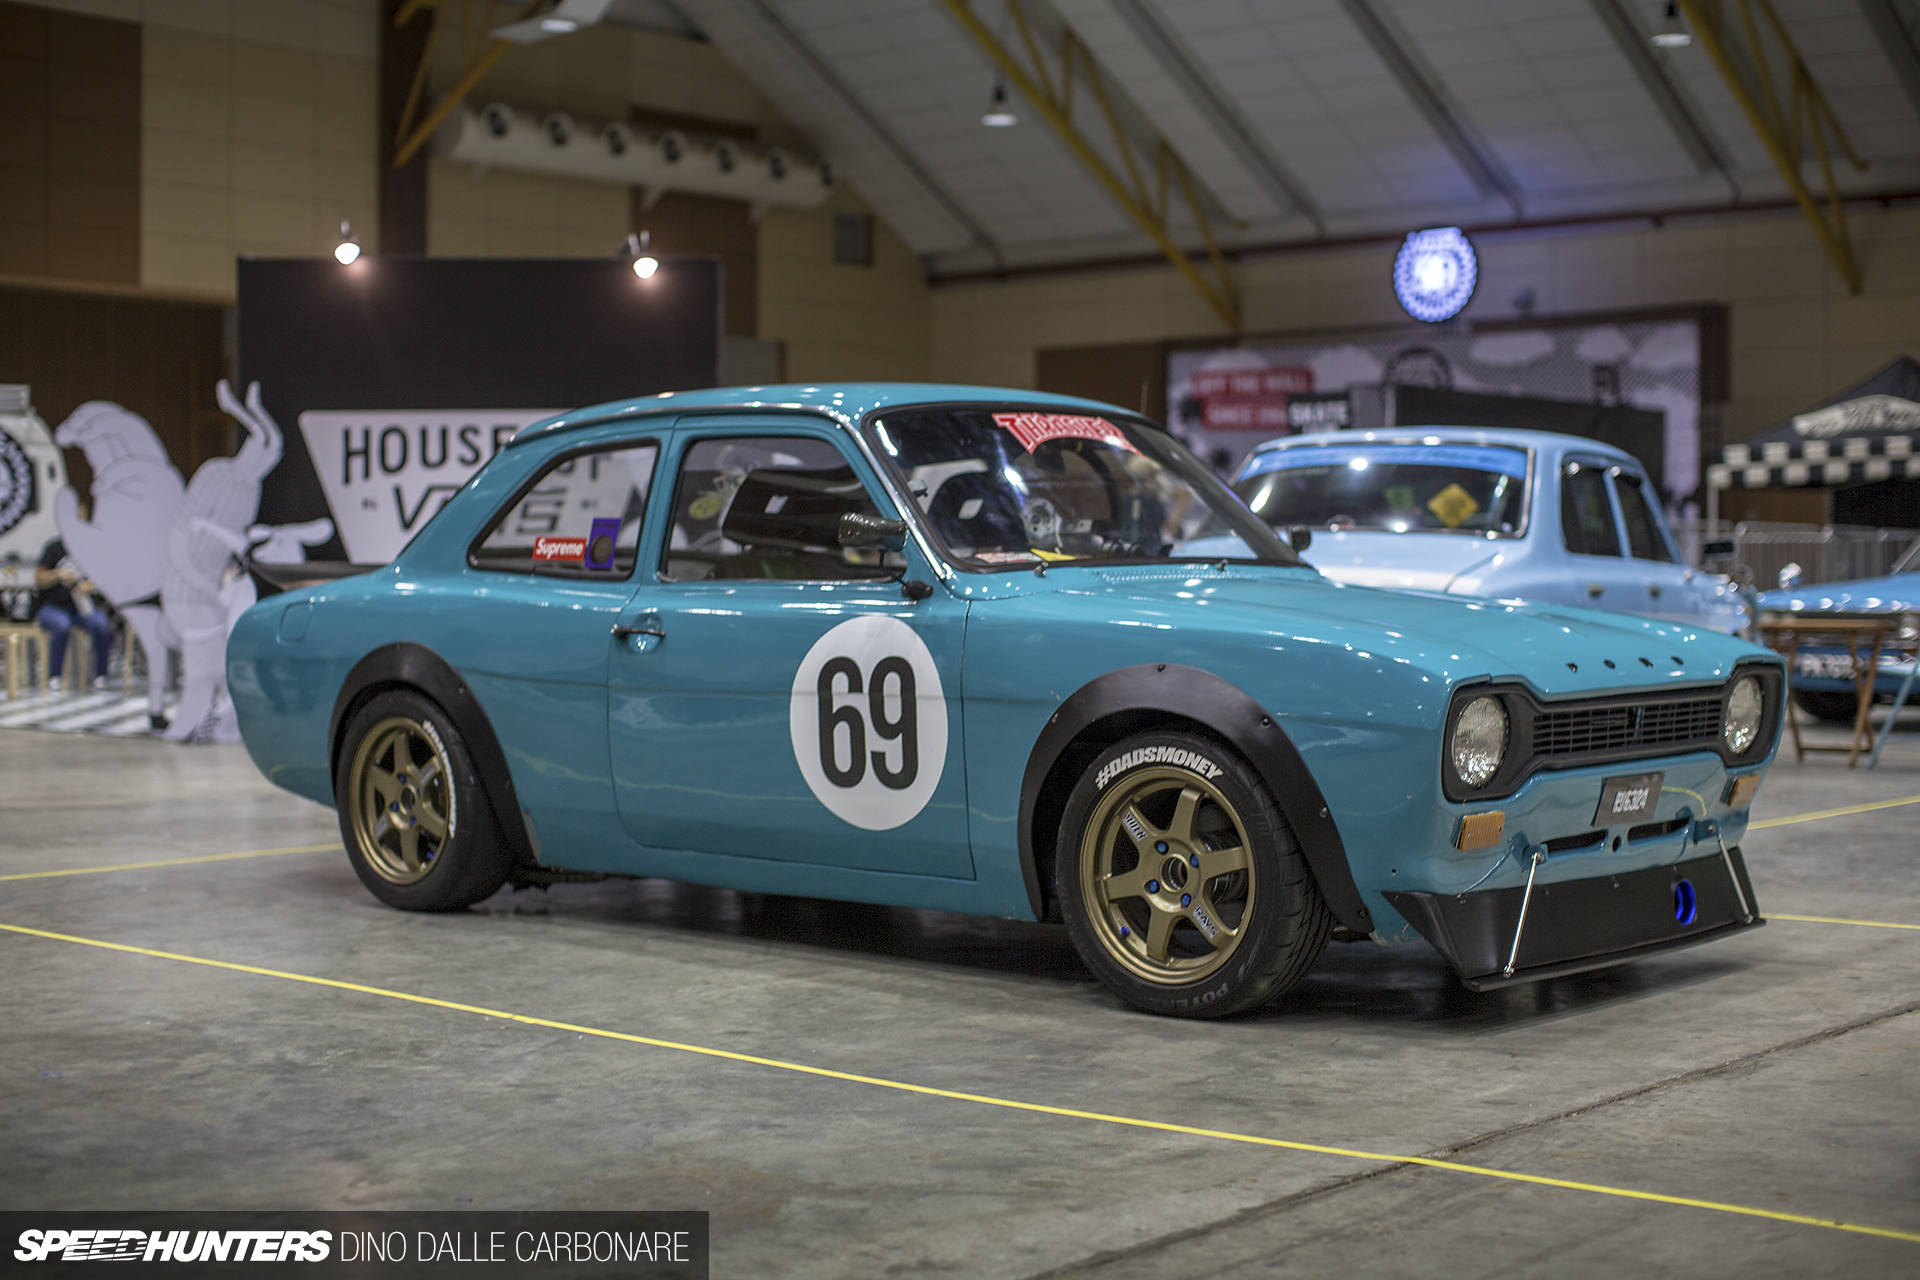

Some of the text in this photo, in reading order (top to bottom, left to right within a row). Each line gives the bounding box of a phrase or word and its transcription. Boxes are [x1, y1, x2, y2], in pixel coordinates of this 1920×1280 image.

[535, 537, 584, 560] Supreme
[817, 656, 919, 790] 69
[1095, 746, 1224, 791] #DADSMONEY
